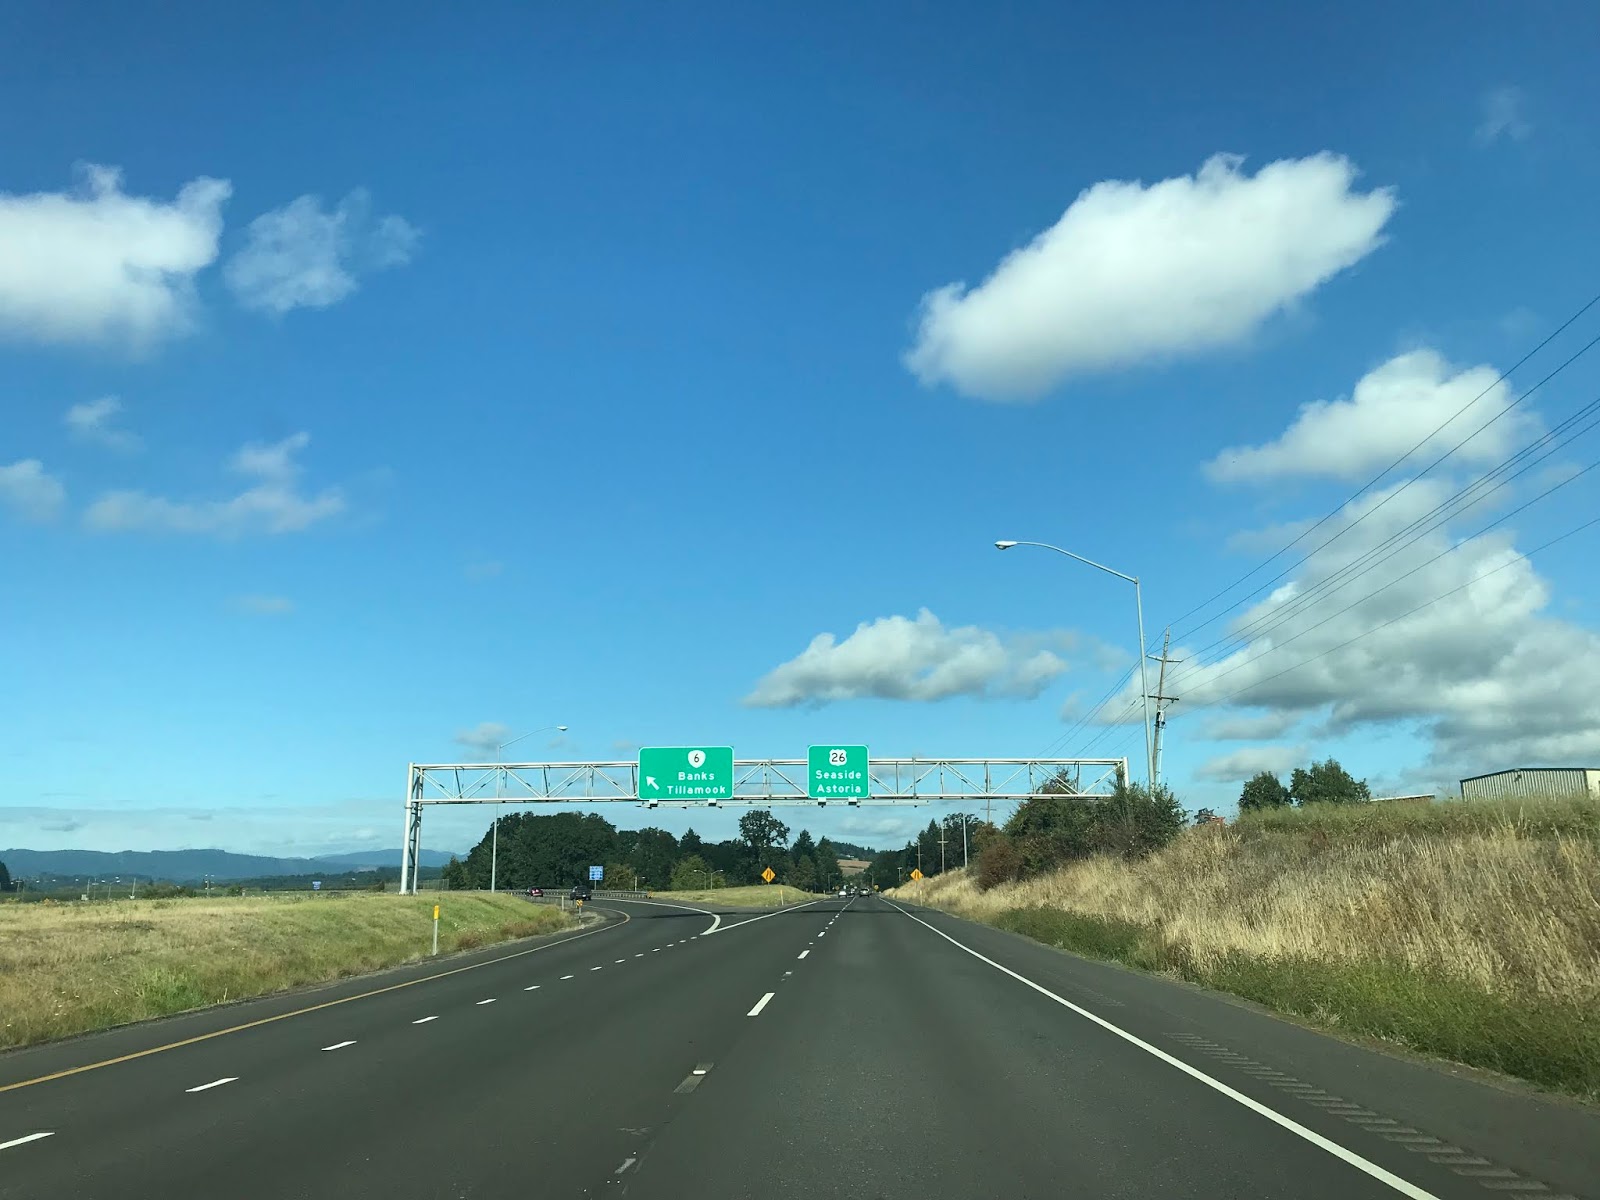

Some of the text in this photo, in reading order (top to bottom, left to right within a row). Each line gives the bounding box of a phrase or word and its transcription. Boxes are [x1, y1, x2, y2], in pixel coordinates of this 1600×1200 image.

[693, 753, 700, 763] 6
[831, 752, 846, 763] 26
[677, 771, 715, 781] Banks
[815, 769, 862, 780] Seaside
[667, 785, 726, 795] Tillamook
[816, 783, 862, 794] Astoria
